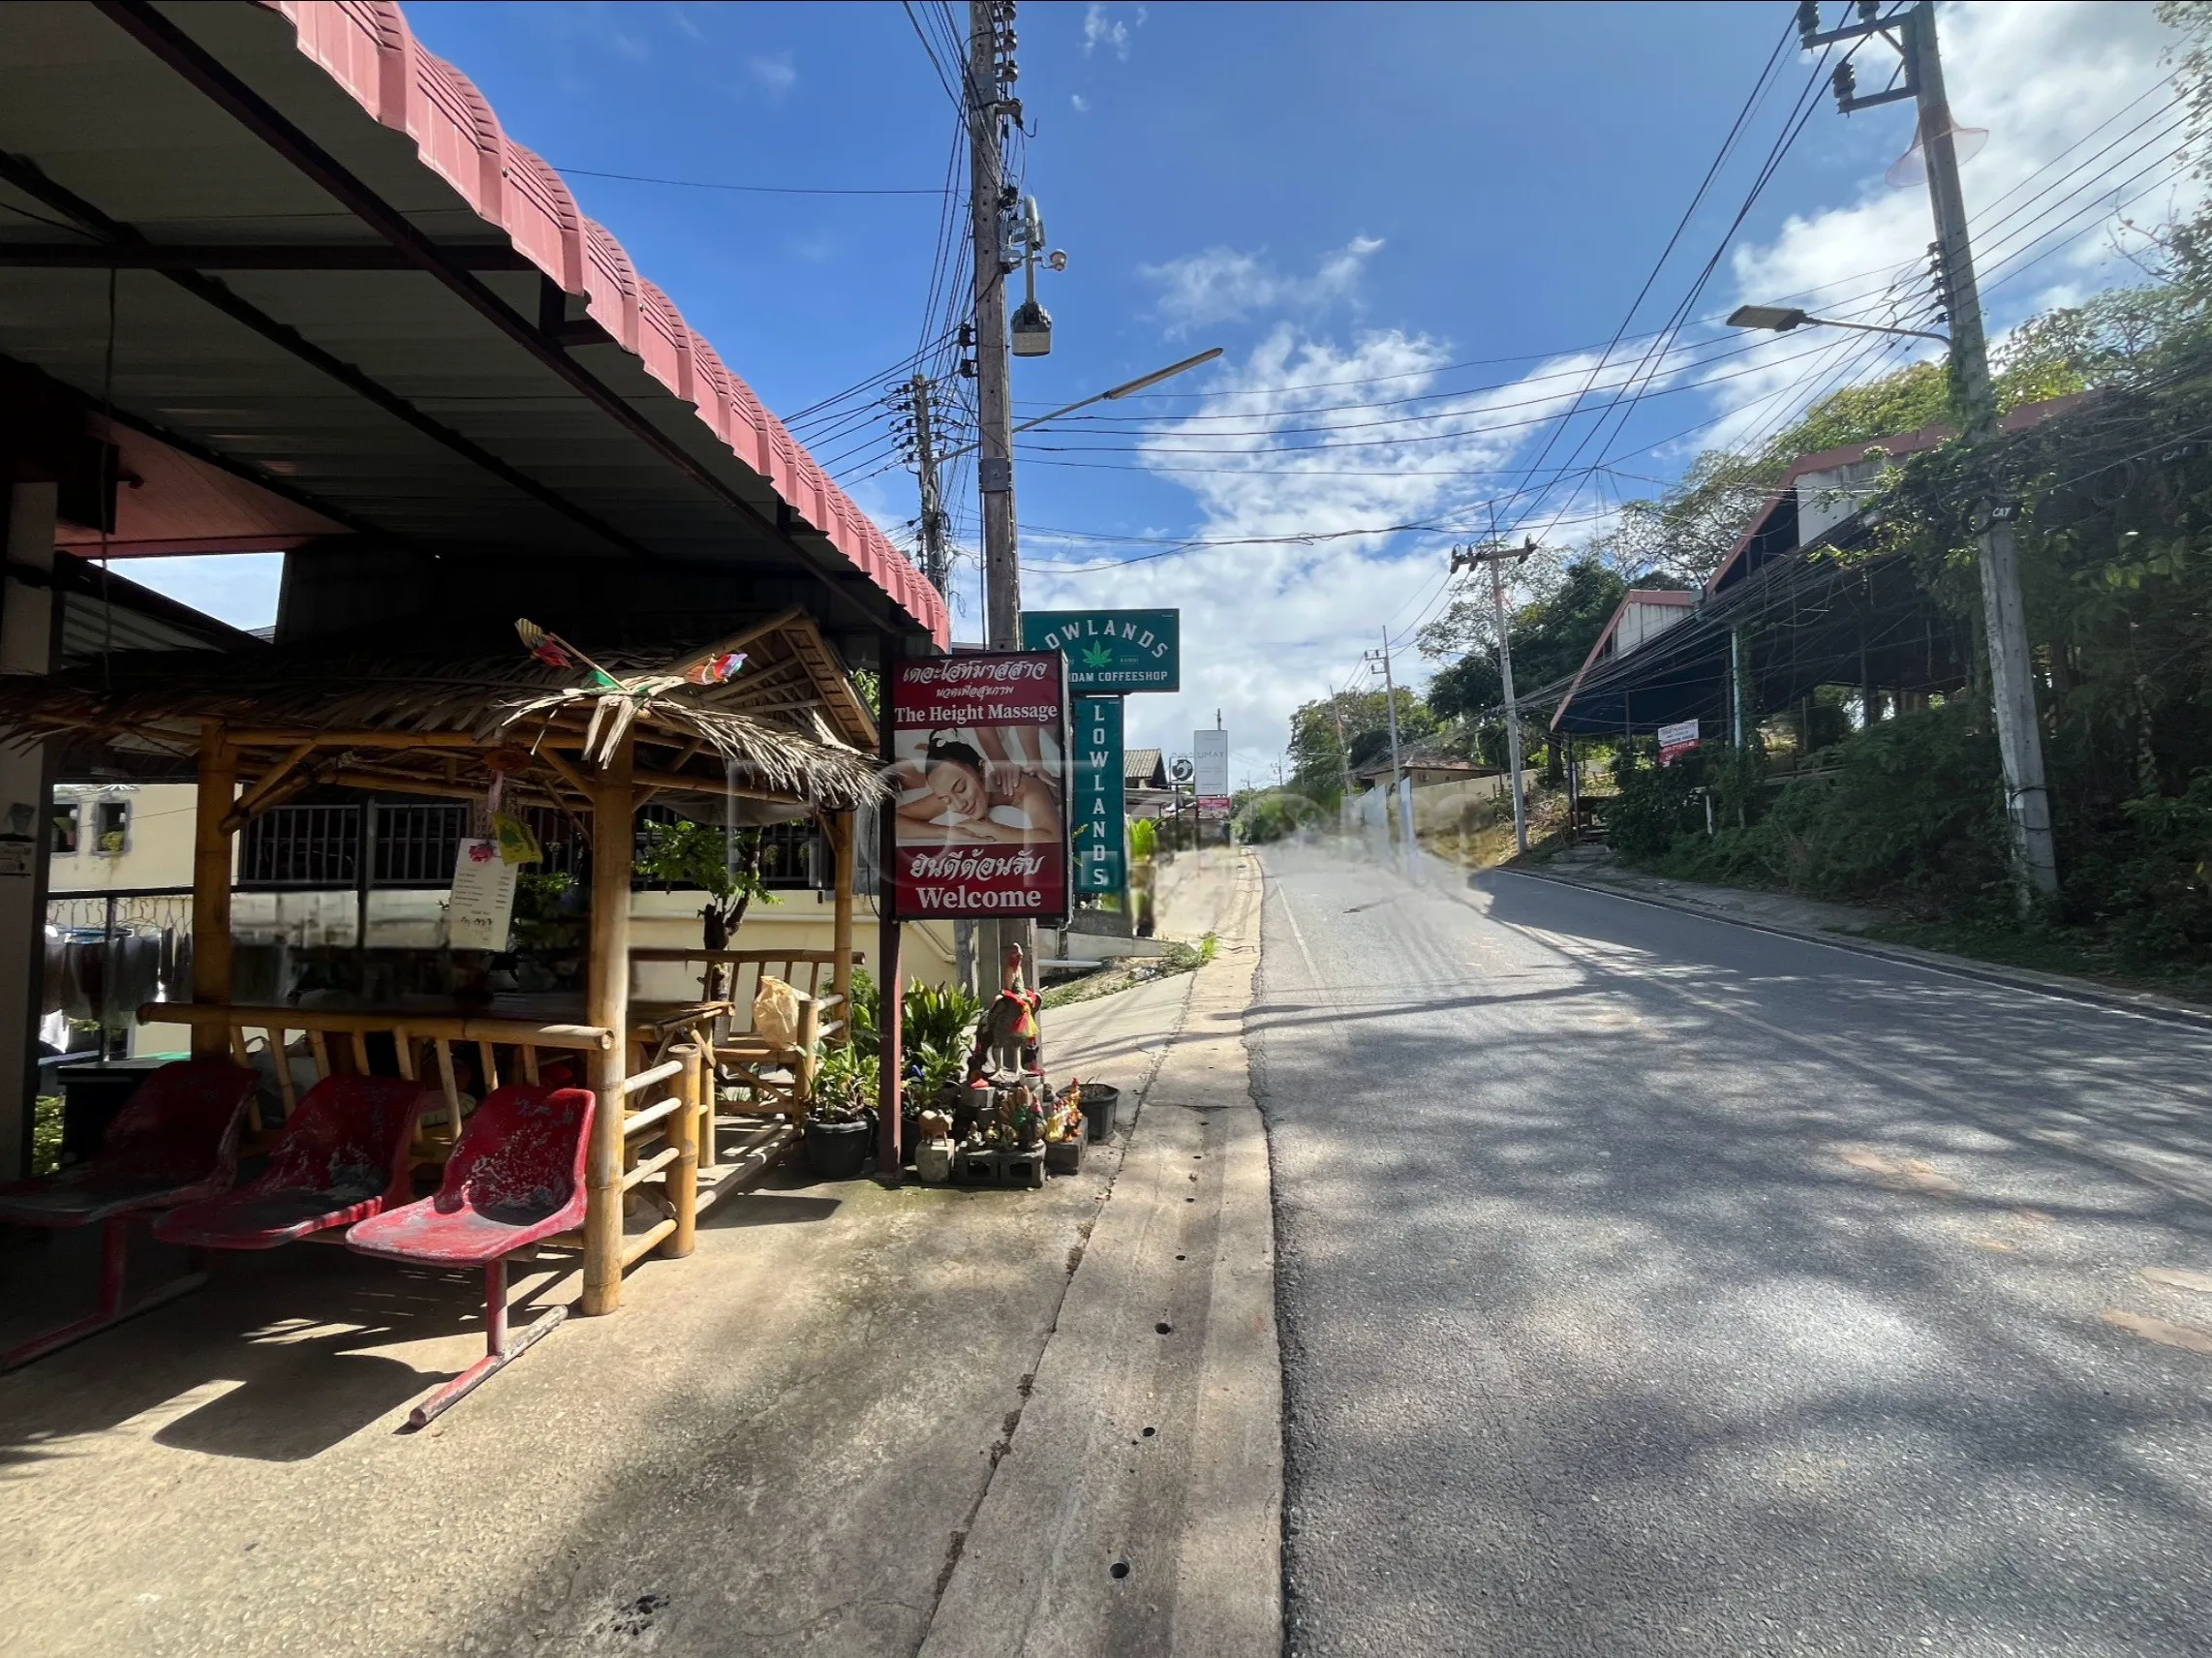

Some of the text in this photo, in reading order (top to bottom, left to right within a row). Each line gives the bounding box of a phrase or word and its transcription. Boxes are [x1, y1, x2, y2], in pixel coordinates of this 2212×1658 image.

[1992, 507, 2012, 517] CAT
[1031, 619, 1169, 659] OWLANDS
[1098, 671, 1168, 682] COFFEESHOP
[895, 703, 1058, 724] The Height Massage
[1090, 705, 1108, 885] LOWLANDS
[910, 848, 1045, 881] ยินดีต้อนรับ
[915, 885, 1041, 908] Welcome
